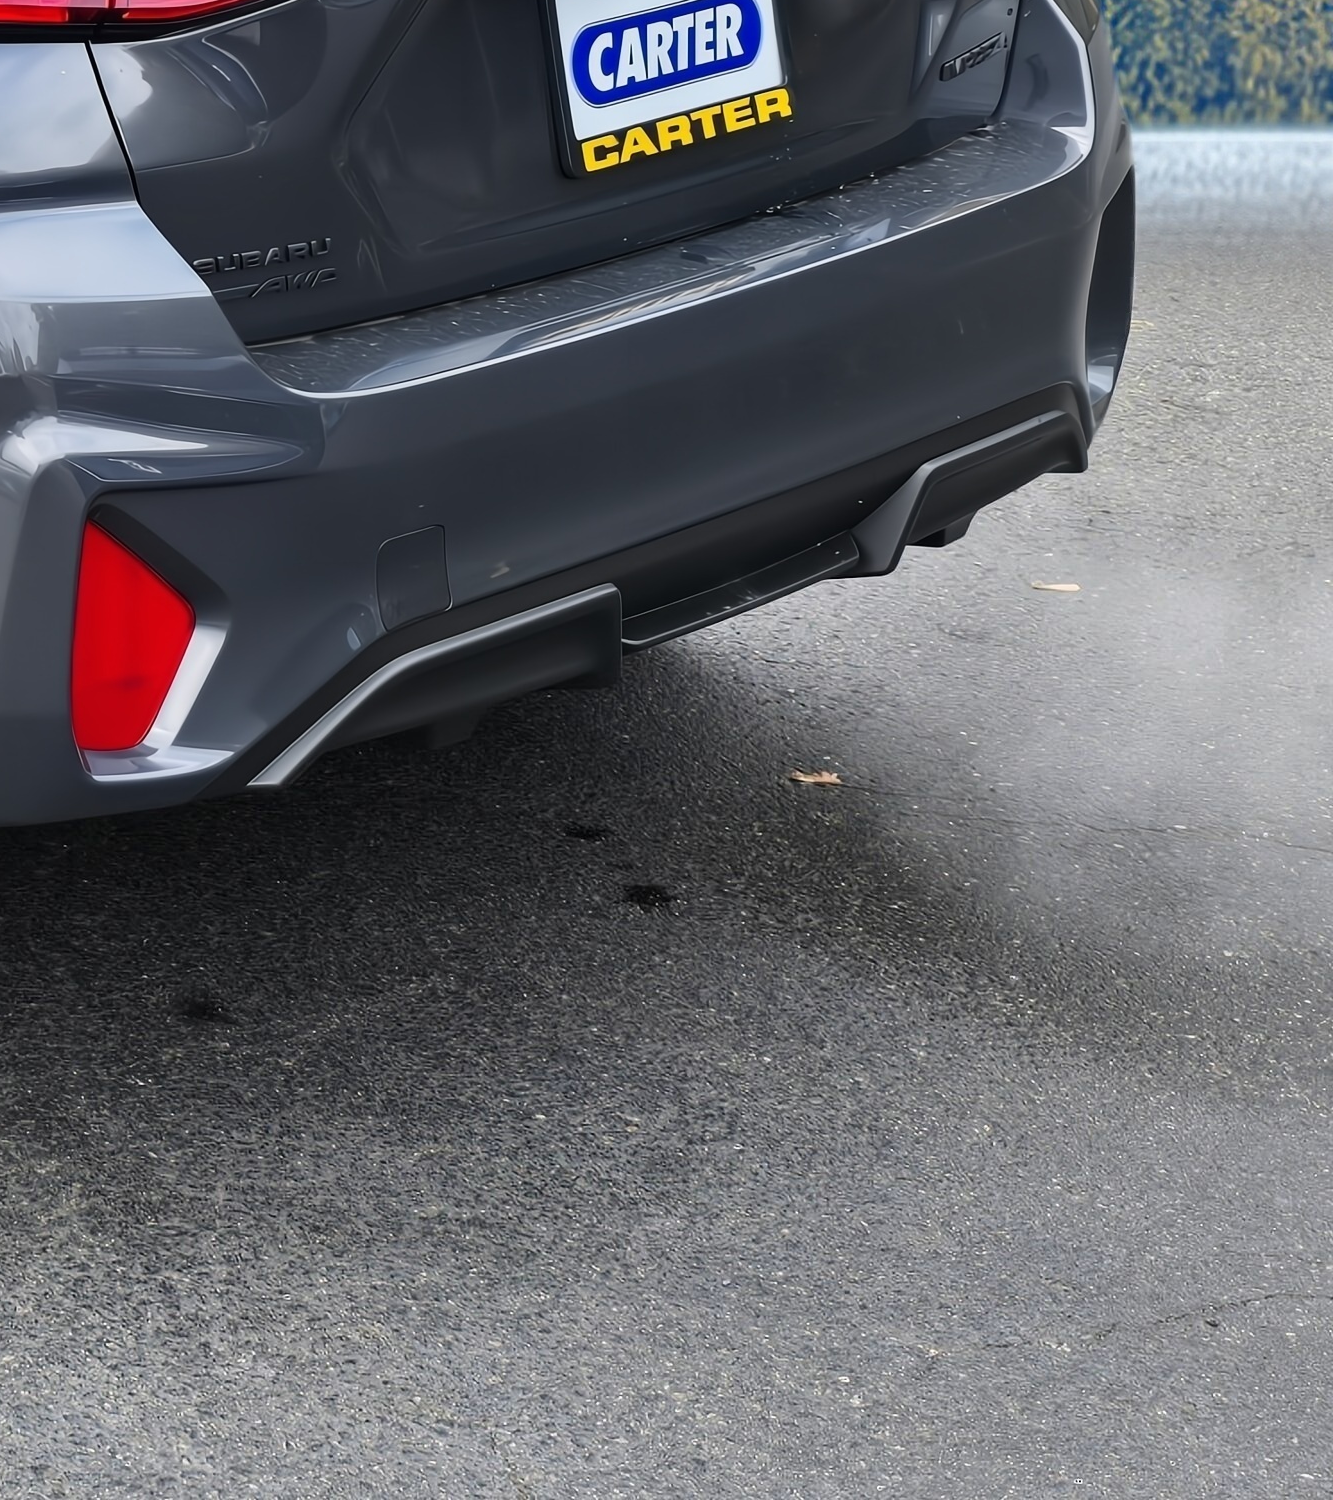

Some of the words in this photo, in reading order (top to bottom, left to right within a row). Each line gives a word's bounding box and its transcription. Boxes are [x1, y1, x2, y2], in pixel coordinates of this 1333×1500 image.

[587, 2, 745, 92] CARTER
[581, 87, 793, 173] CARTER
[192, 237, 332, 275] SUBARU
